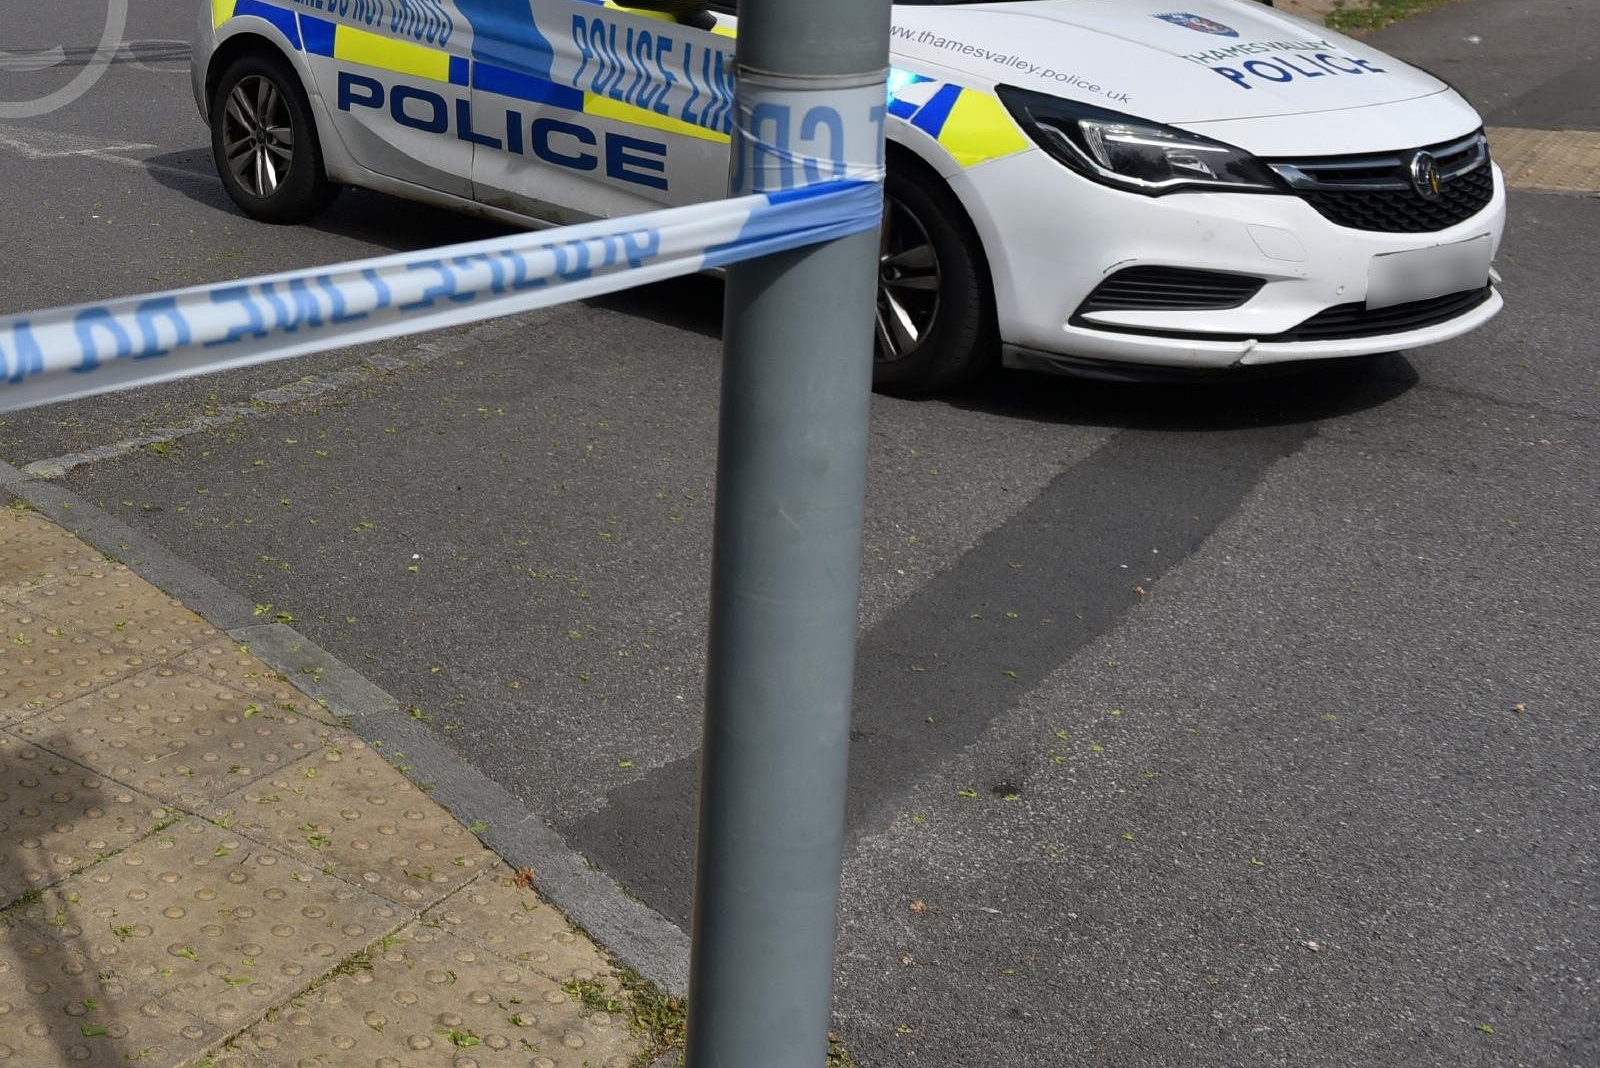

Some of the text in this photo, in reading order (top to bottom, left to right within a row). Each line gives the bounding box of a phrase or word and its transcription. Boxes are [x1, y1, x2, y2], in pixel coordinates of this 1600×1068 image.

[572, 14, 737, 135] POLICE LIN
[889, 25, 1133, 105] ww.thamesvalley.police.uk
[1178, 40, 1337, 65] THAMES VALLEY
[1210, 53, 1388, 89] POLICE
[337, 71, 669, 191] POLICE
